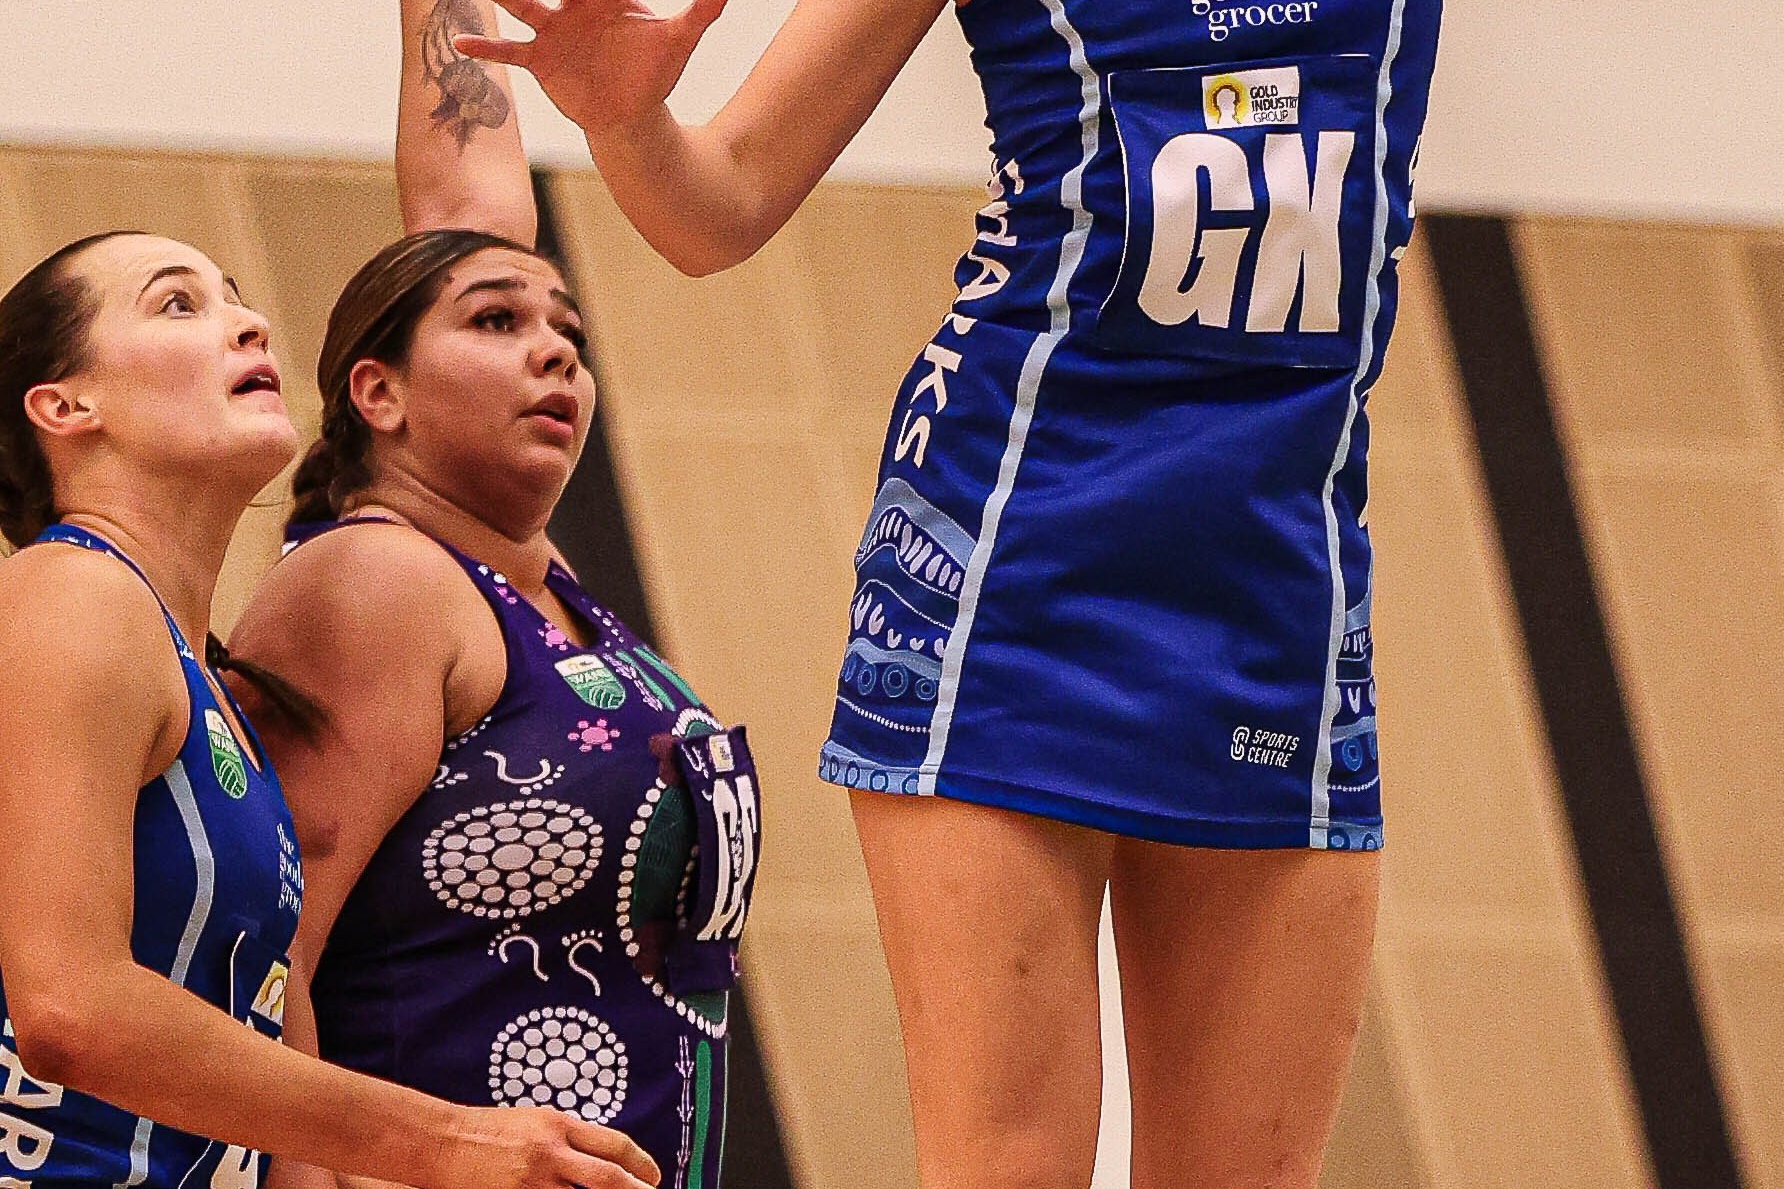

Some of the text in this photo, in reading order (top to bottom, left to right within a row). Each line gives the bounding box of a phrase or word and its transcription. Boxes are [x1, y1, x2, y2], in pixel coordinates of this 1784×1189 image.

[1208, 1, 1318, 42] grocer
[1250, 85, 1278, 99] GOLD
[1253, 110, 1289, 122] GROUP
[1252, 729, 1300, 751] SPORTS
[1247, 746, 1293, 768] CENTRE
